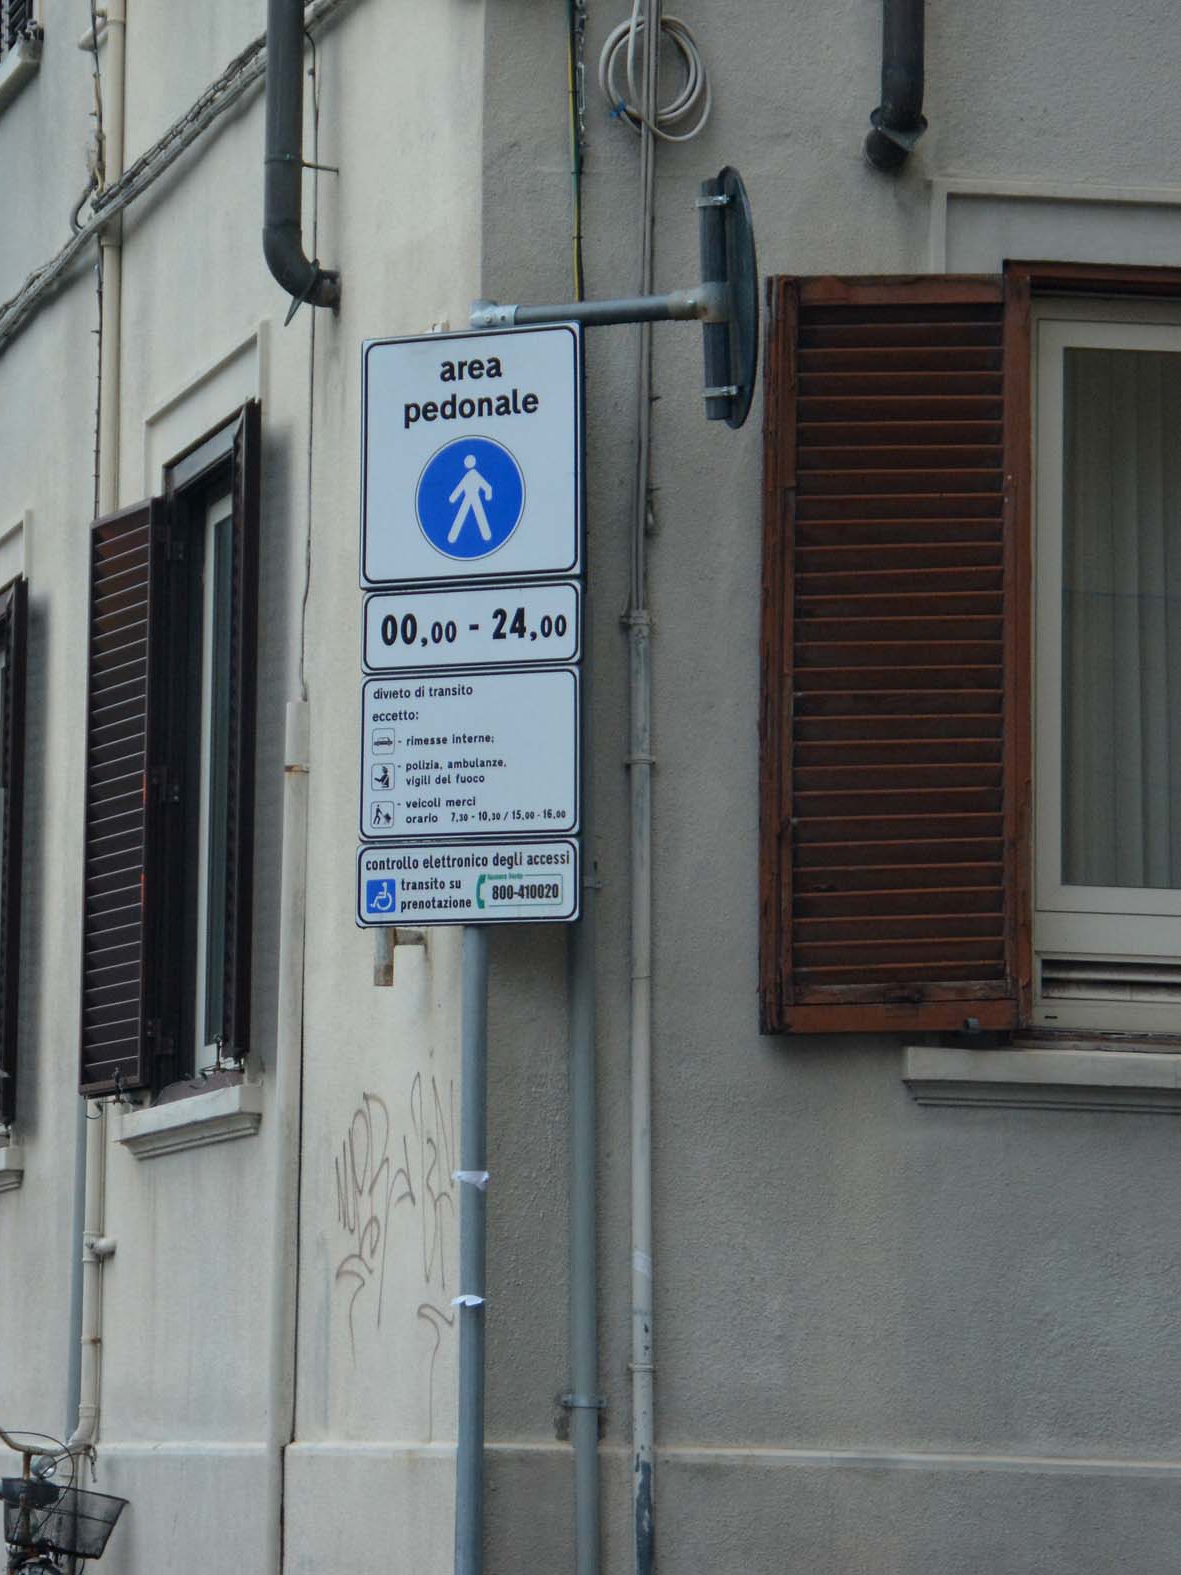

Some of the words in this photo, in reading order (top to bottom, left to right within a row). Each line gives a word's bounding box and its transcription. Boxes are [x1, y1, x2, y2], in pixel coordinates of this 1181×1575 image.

[440, 356, 502, 382] area
[404, 388, 539, 429] pedonale
[381, 613, 457, 647] 00,00
[469, 623, 480, 631] -
[492, 607, 567, 641] 24,00
[373, 688, 411, 700] divieto
[415, 685, 425, 698] di
[429, 684, 473, 697] transito
[372, 709, 419, 722] eccetto:
[406, 736, 448, 746] rimesse
[406, 773, 431, 787] vigili
[435, 774, 451, 784] del
[456, 773, 485, 783] fuoco
[406, 797, 441, 808] veicoli
[446, 796, 476, 807] merci
[406, 813, 438, 824] orario
[366, 857, 419, 871] controllo
[423, 853, 488, 869] elettronico
[492, 853, 523, 869] degli
[527, 850, 570, 865] accessi
[401, 878, 445, 891] transito
[449, 880, 462, 889] su
[492, 884, 559, 900] 800-410020
[400, 897, 472, 912] prenotazione
